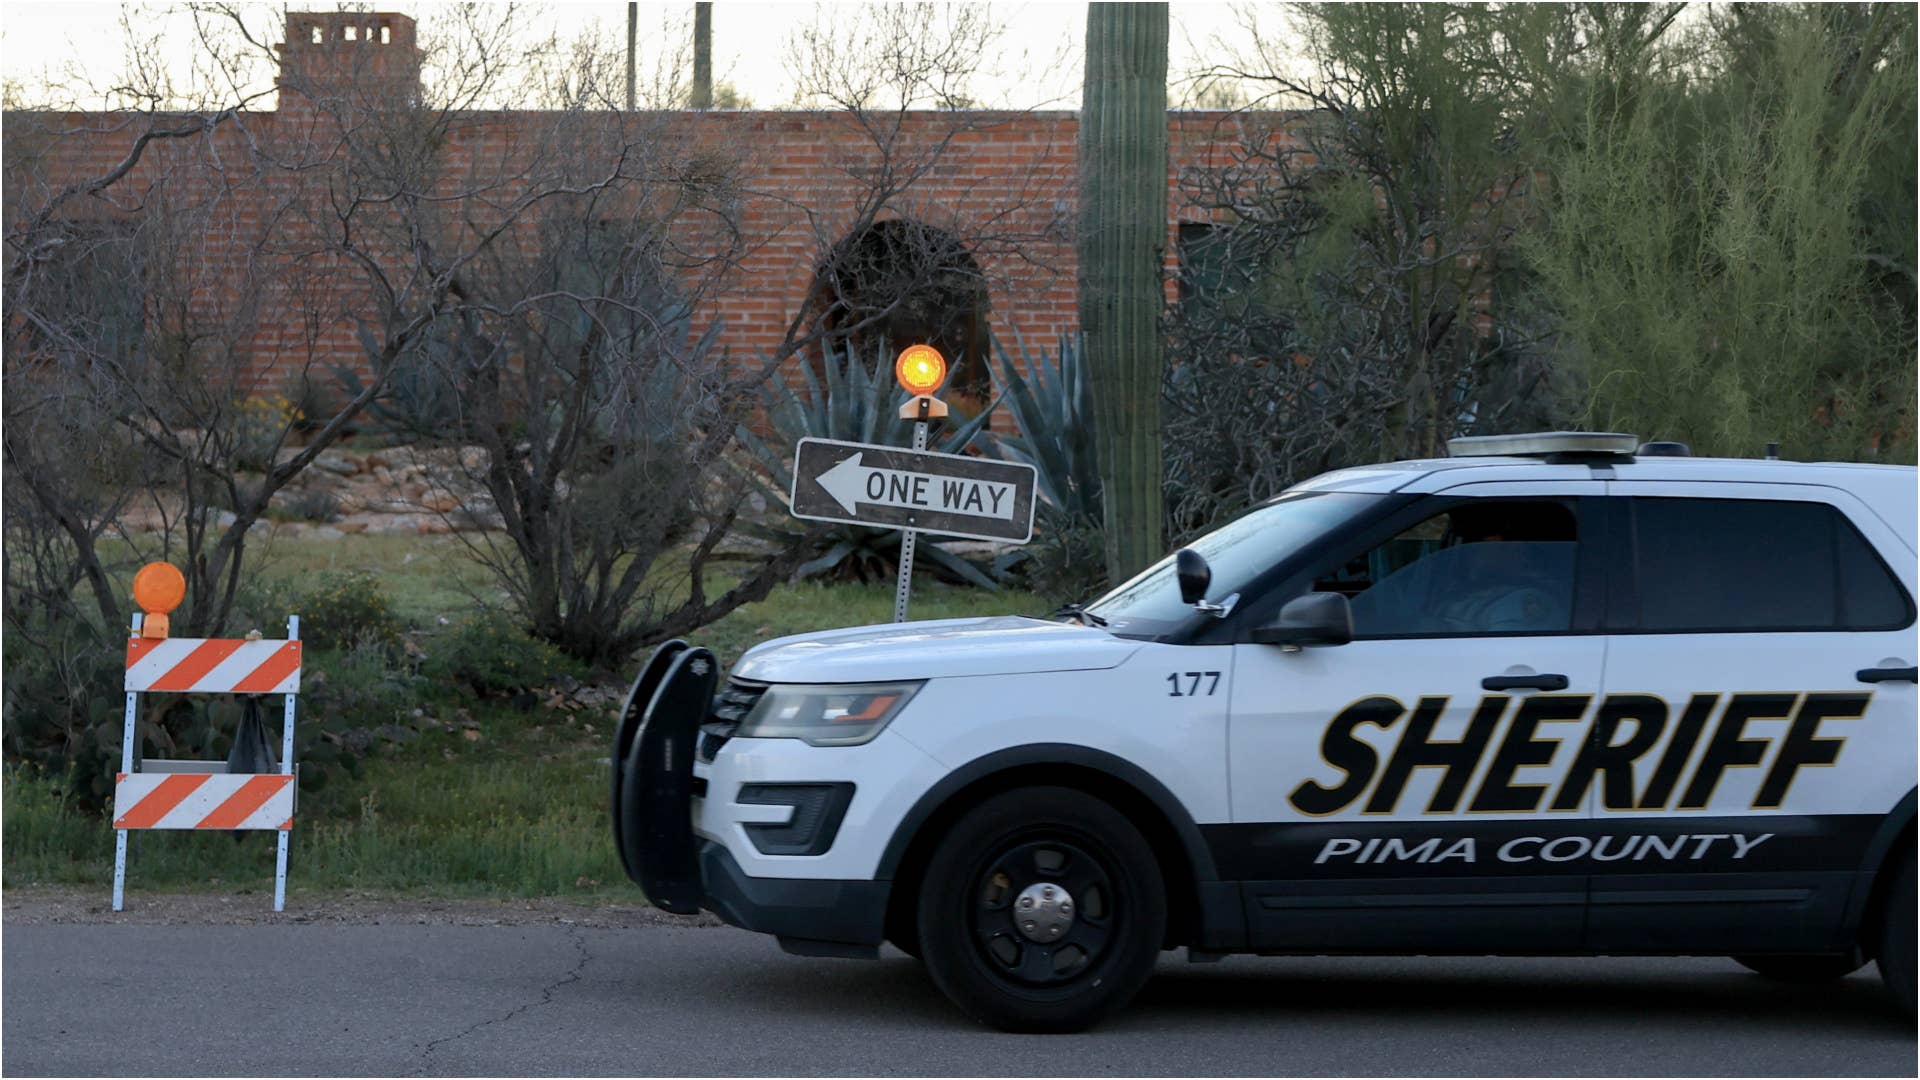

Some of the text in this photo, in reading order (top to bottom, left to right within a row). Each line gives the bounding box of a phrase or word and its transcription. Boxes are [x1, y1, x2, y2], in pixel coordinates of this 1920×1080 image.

[867, 472, 1007, 513] ONE WAY
[1166, 671, 1221, 697] 177
[1287, 692, 1872, 816] SHERIFF
[1314, 834, 1775, 863] PIMA COUNTY
